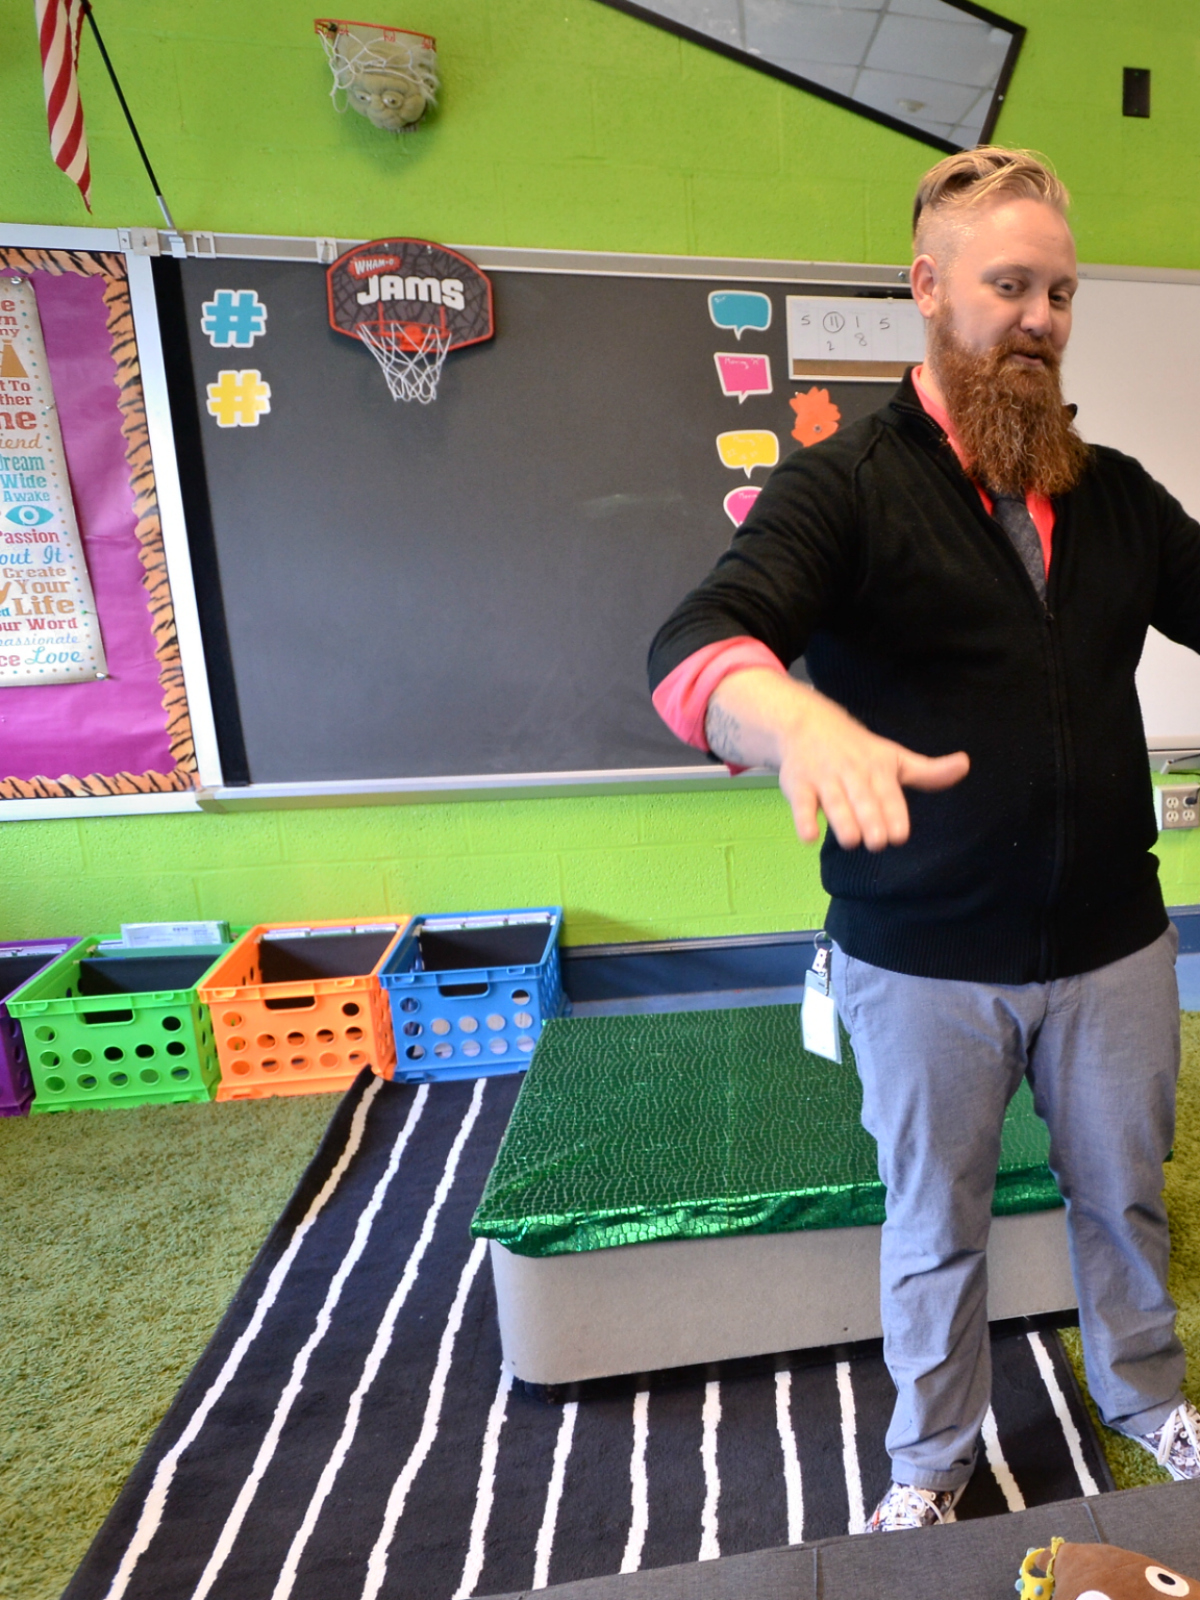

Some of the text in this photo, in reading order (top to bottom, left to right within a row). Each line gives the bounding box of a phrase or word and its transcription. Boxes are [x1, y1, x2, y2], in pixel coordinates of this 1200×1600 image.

[356, 274, 466, 312] JAMS
[8, 380, 31, 391] To
[0, 472, 47, 489] Wide
[3, 490, 50, 502] Awake
[0, 528, 60, 544] assion
[43, 545, 65, 565] It
[2, 567, 67, 578] Create
[14, 579, 71, 594] Your
[11, 595, 75, 616] Life
[26, 617, 79, 631] Word
[24, 646, 85, 665] Love
